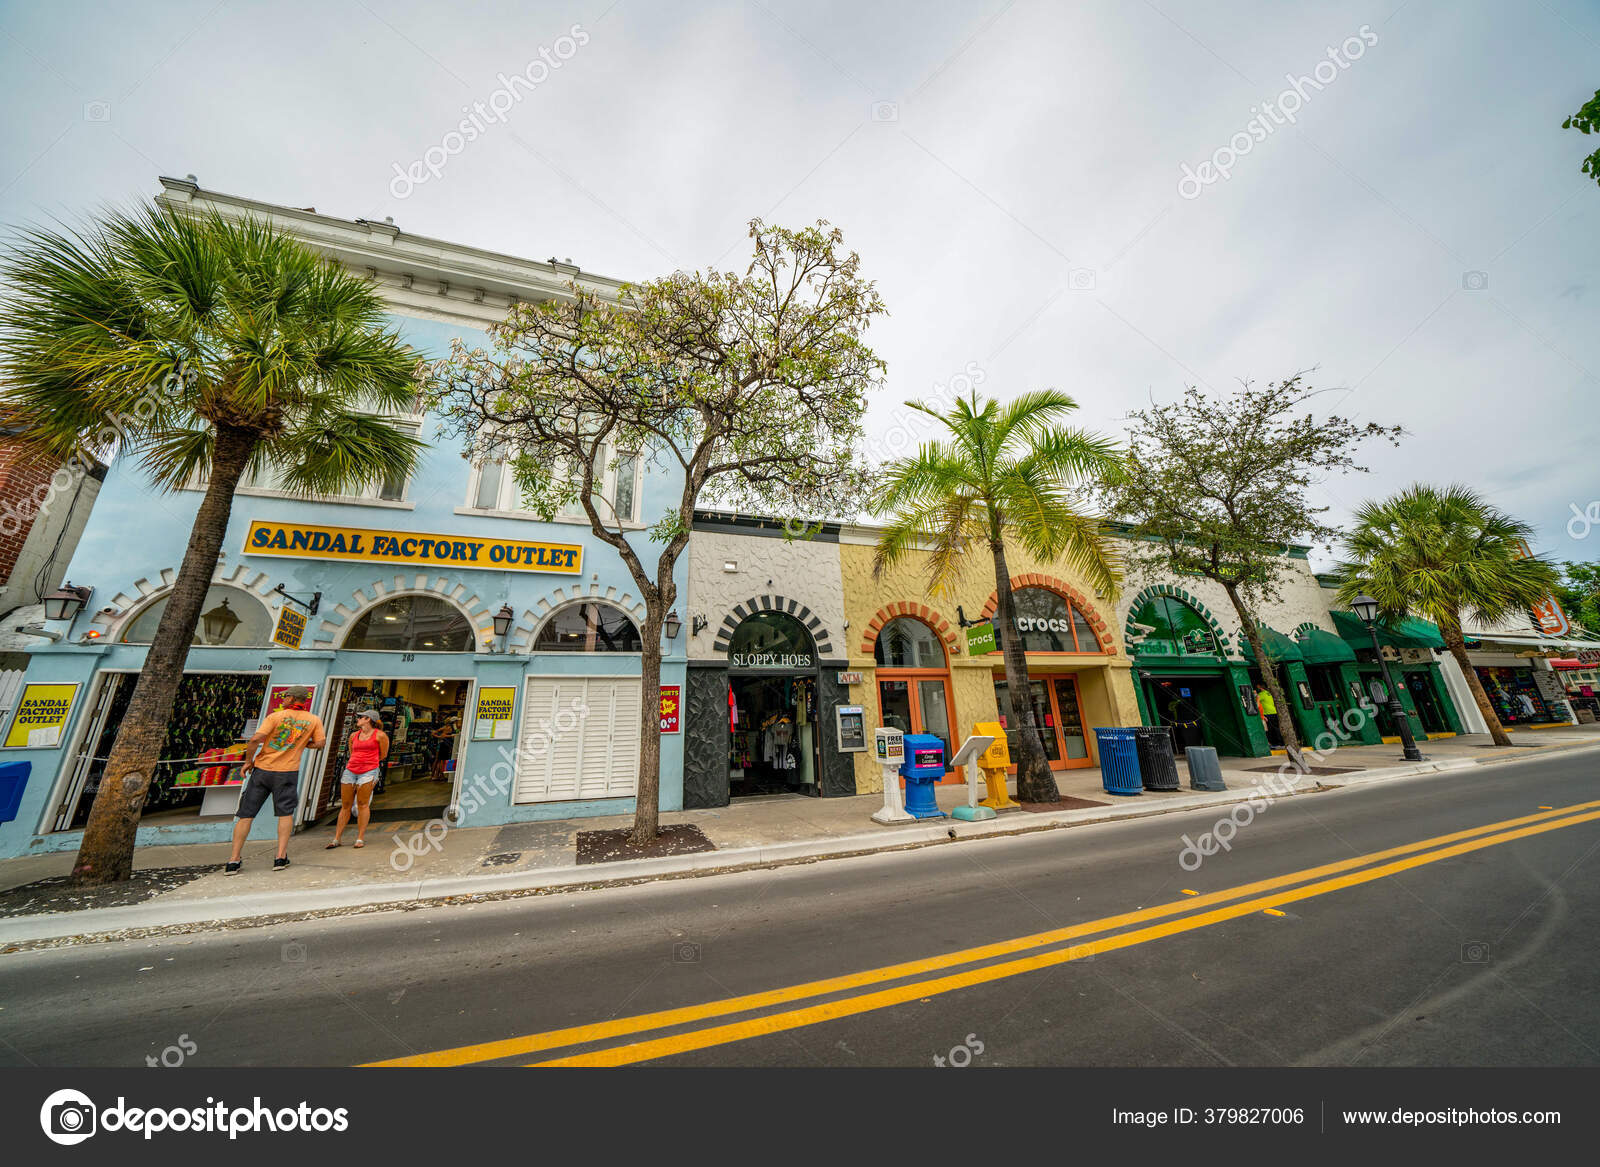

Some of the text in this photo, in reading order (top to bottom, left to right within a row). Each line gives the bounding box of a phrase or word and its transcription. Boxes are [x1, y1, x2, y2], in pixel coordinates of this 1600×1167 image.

[252, 527, 578, 567] SANDAL FACTORY OUTLET
[282, 610, 305, 627] SANDAL
[1017, 617, 1069, 632] crocs
[278, 619, 304, 637] FACTORY
[276, 630, 300, 647] OUTLET
[968, 633, 993, 647] crocs
[733, 653, 811, 666] SLOPPY HOES
[840, 672, 861, 683] ATM
[24, 699, 69, 707] SANDAL
[18, 707, 69, 715] FACTORY
